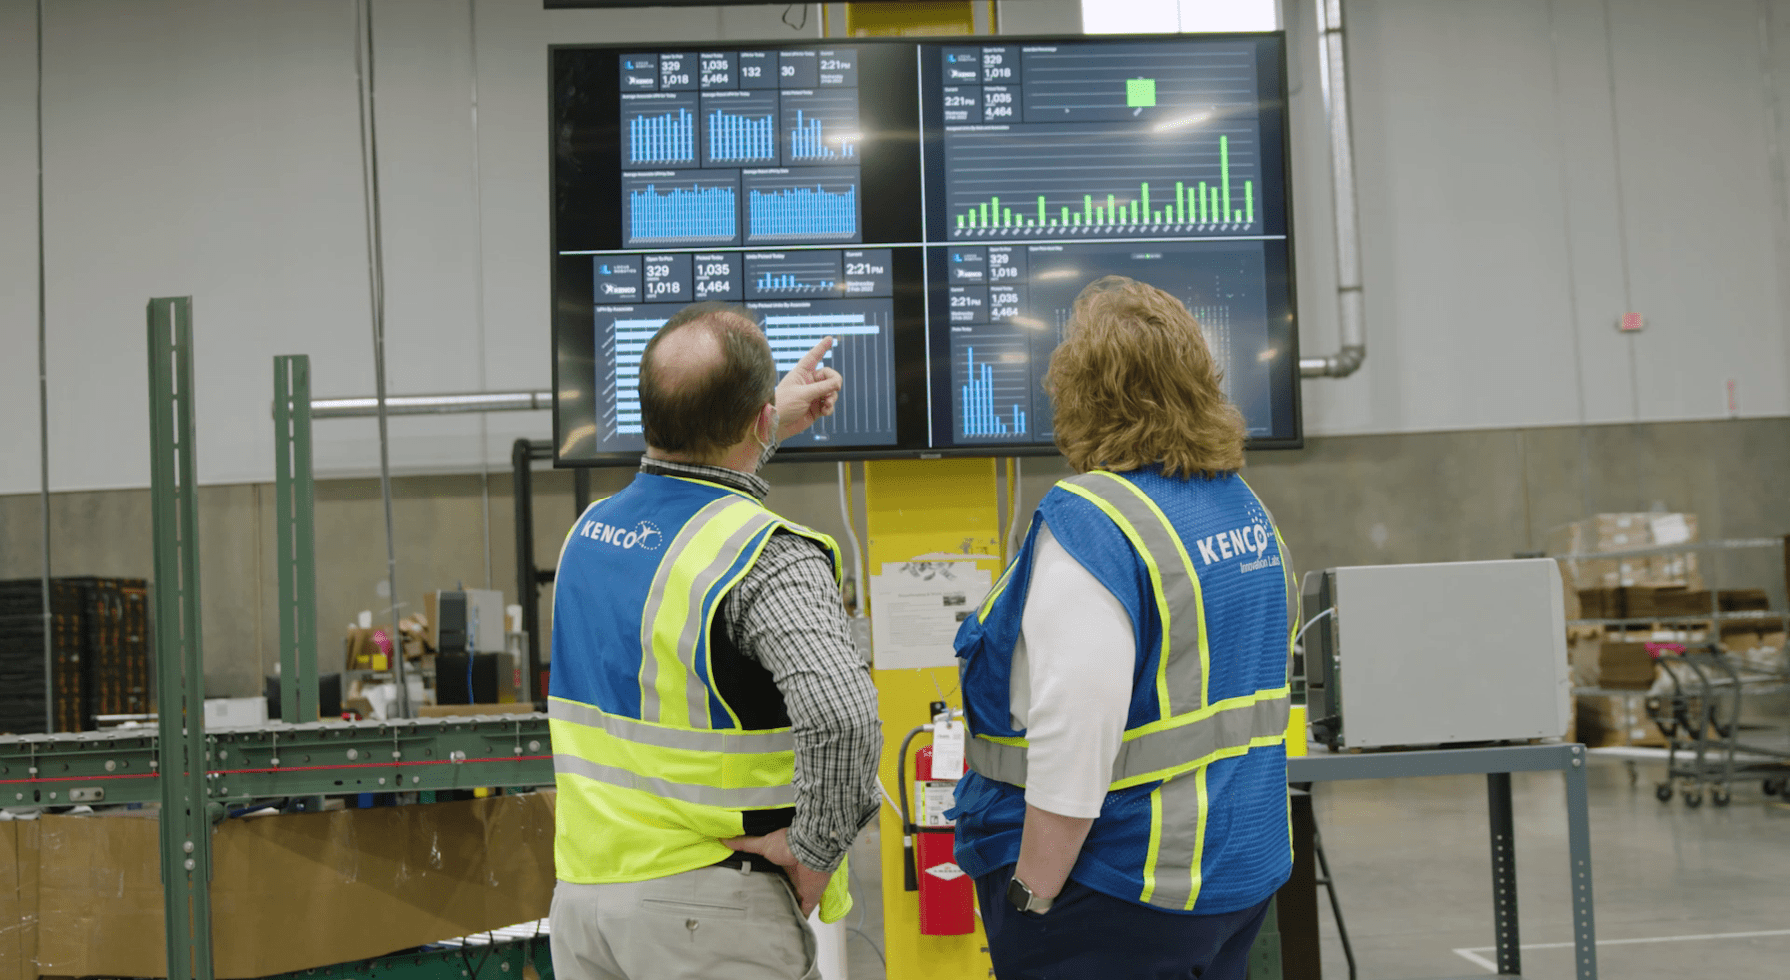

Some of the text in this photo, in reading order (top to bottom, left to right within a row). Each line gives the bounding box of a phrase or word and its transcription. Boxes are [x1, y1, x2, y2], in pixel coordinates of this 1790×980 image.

[702, 60, 729, 71] 1,035
[983, 54, 1003, 65] 329
[661, 61, 681, 71] 329
[742, 66, 761, 77] 132
[781, 65, 795, 77] 30
[662, 74, 689, 85] 1,018
[701, 74, 729, 85] 4,464
[985, 93, 1012, 104] 1,035
[646, 264, 669, 277] 329
[697, 263, 730, 276] 1,035
[647, 281, 681, 295] 1,018
[696, 280, 730, 294] 4,464
[580, 520, 637, 549] KENCO
[1196, 524, 1268, 566] KENCO
[1240, 554, 1281, 574] Innovation Labs
